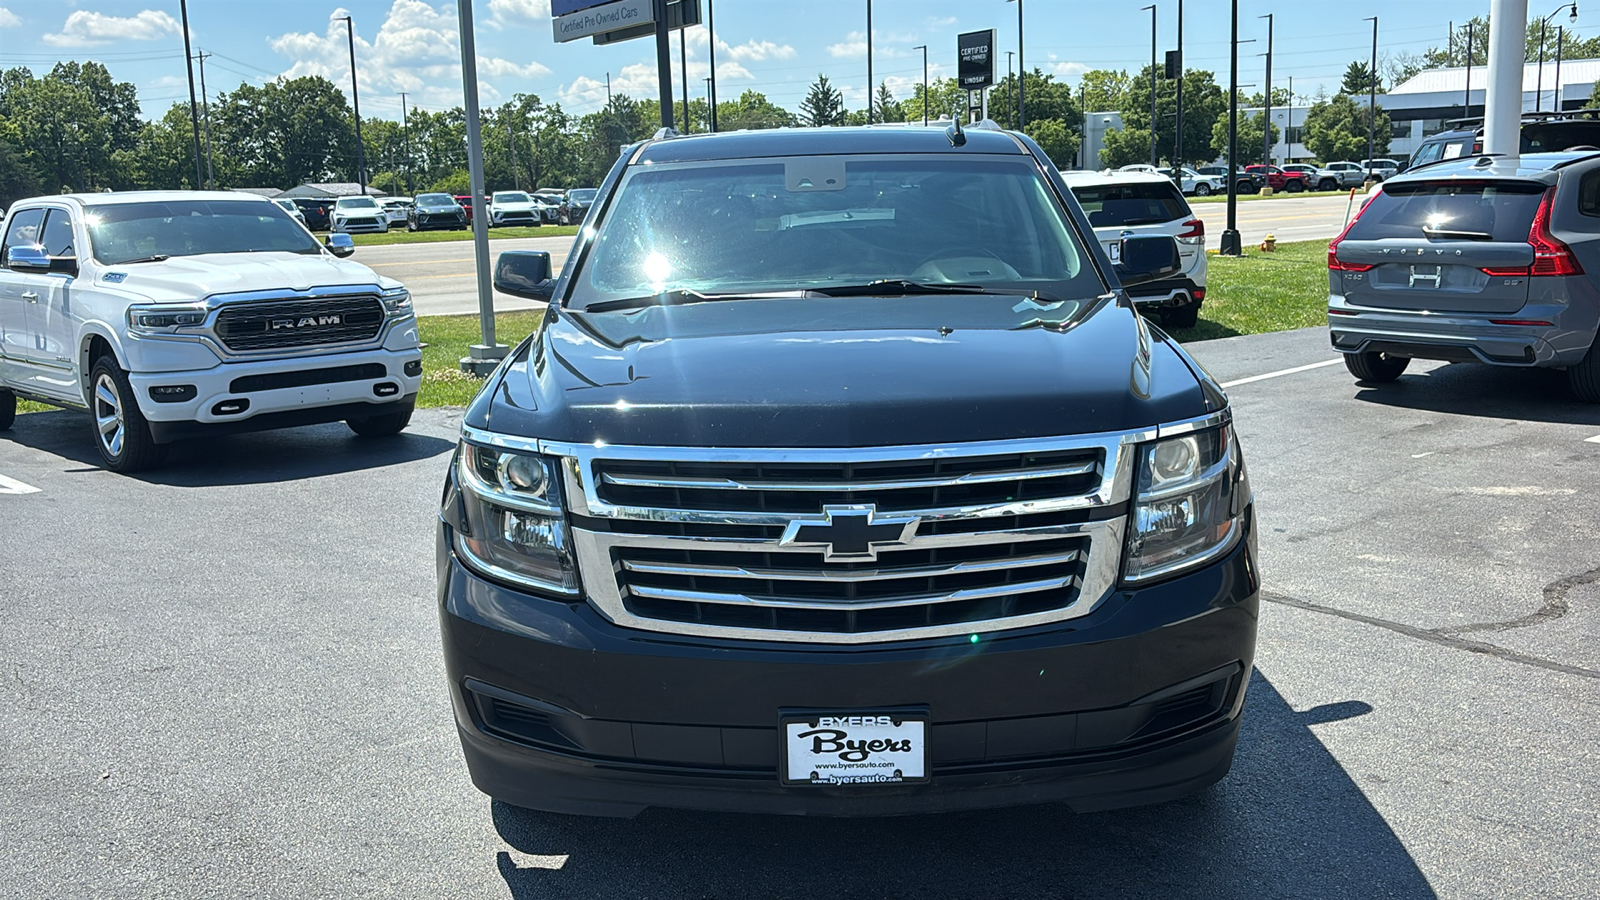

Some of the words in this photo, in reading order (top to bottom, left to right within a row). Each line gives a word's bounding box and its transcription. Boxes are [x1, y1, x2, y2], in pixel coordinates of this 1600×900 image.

[560, 17, 584, 34] Certified
[584, 16, 595, 28] Pre
[596, 10, 620, 25] Owned
[621, 7, 639, 19] Cars
[961, 45, 988, 56] CERTIFIED
[963, 54, 987, 62] PRE-OWNED
[964, 76, 985, 84] LINDSAY
[1383, 248, 1462, 256] VOLVO
[272, 314, 341, 330] RAM
[818, 716, 892, 728] BYERS
[797, 729, 912, 762] Byers
[815, 762, 895, 770] www.byersauto.com
[811, 774, 903, 785] www.byersauto.com
